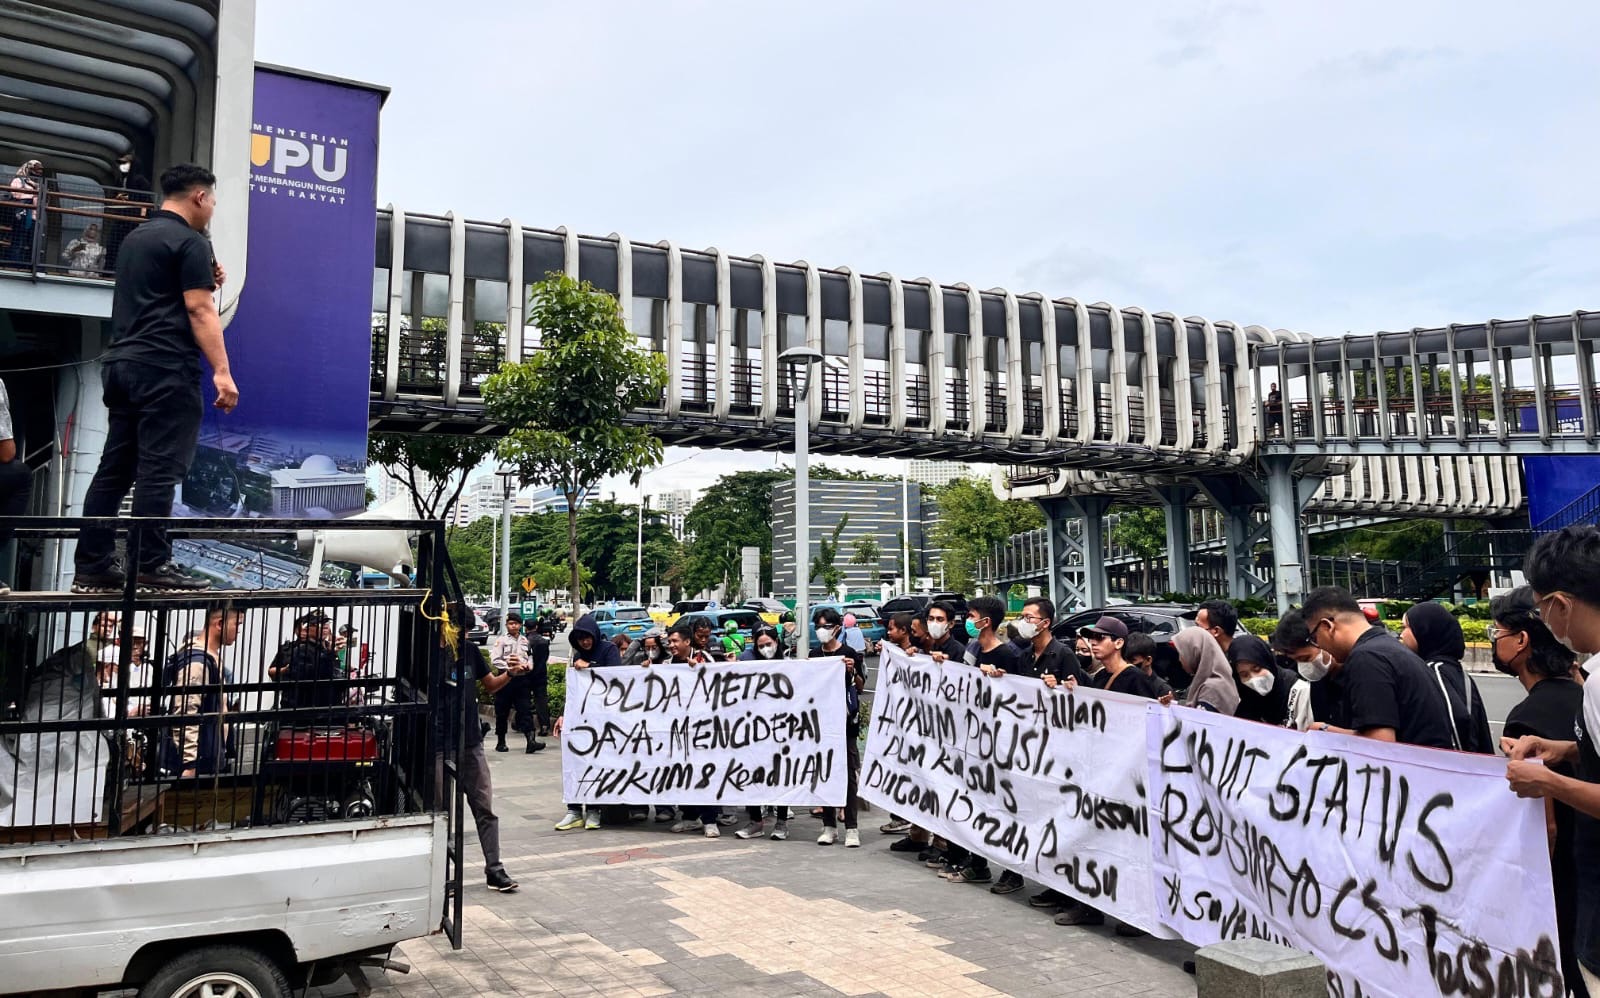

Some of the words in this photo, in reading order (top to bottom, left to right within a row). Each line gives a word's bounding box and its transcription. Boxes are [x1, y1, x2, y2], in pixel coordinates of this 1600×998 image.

[252, 123, 348, 146] MENTERIAN
[249, 183, 278, 194] TUK
[288, 189, 345, 205] RAKYAT
[255, 174, 313, 190] MEMBANGUN
[315, 184, 346, 195] NEGERI
[580, 669, 681, 715] POLDA
[687, 666, 794, 711] METRO
[576, 761, 693, 798] HUKUM
[1268, 744, 1454, 893] STATUS
